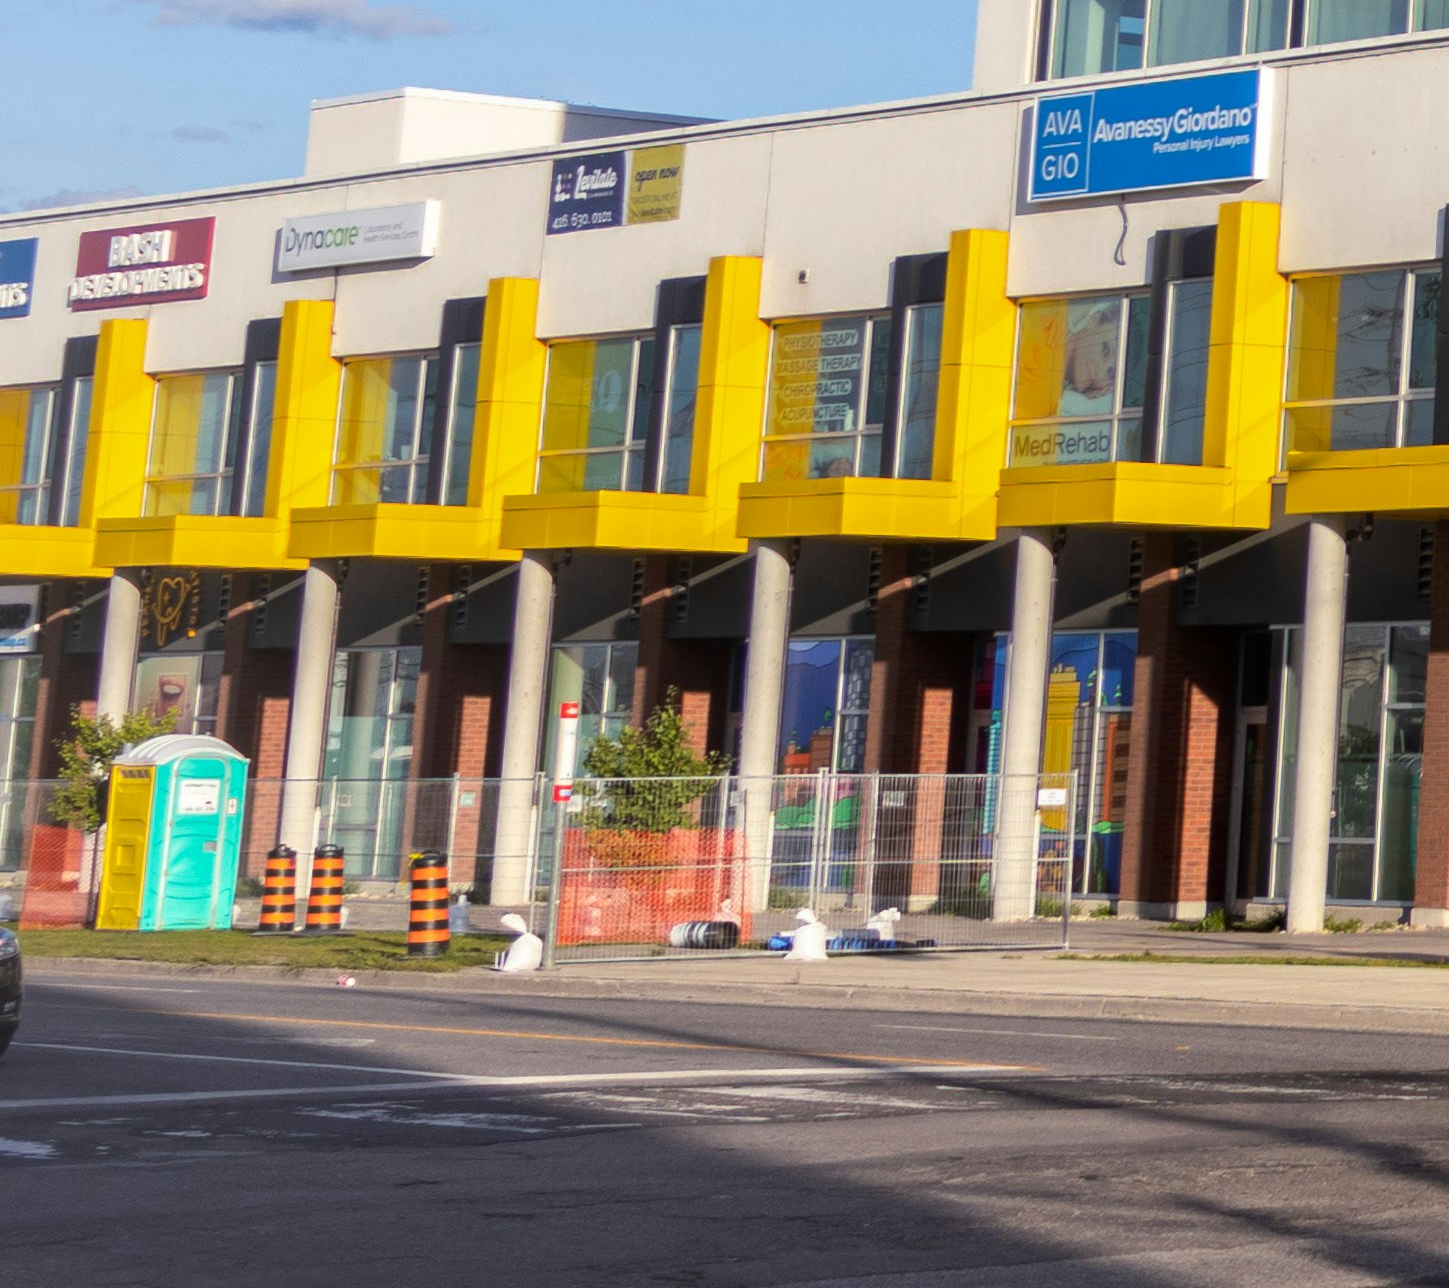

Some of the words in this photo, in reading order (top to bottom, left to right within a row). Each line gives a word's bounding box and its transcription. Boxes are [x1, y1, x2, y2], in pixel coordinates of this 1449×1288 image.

[1042, 109, 1082, 138] AVA
[1152, 138, 1188, 154] Personal
[1190, 136, 1212, 152] Injury
[1214, 134, 1250, 149] Lawyers
[1041, 152, 1079, 181] GIO
[109, 230, 172, 267] BASH
[285, 226, 359, 256] Dynacare
[70, 263, 205, 300] DEVELOPMENTS
[783, 331, 858, 349] PHYSIOTHERAPY
[776, 359, 818, 373] MASSAGE
[821, 354, 861, 370] THERAPY
[784, 380, 850, 398] CHIROPRACTIC
[781, 403, 848, 422] ACUPUNCTURE
[1015, 431, 1110, 457] MedRehab
